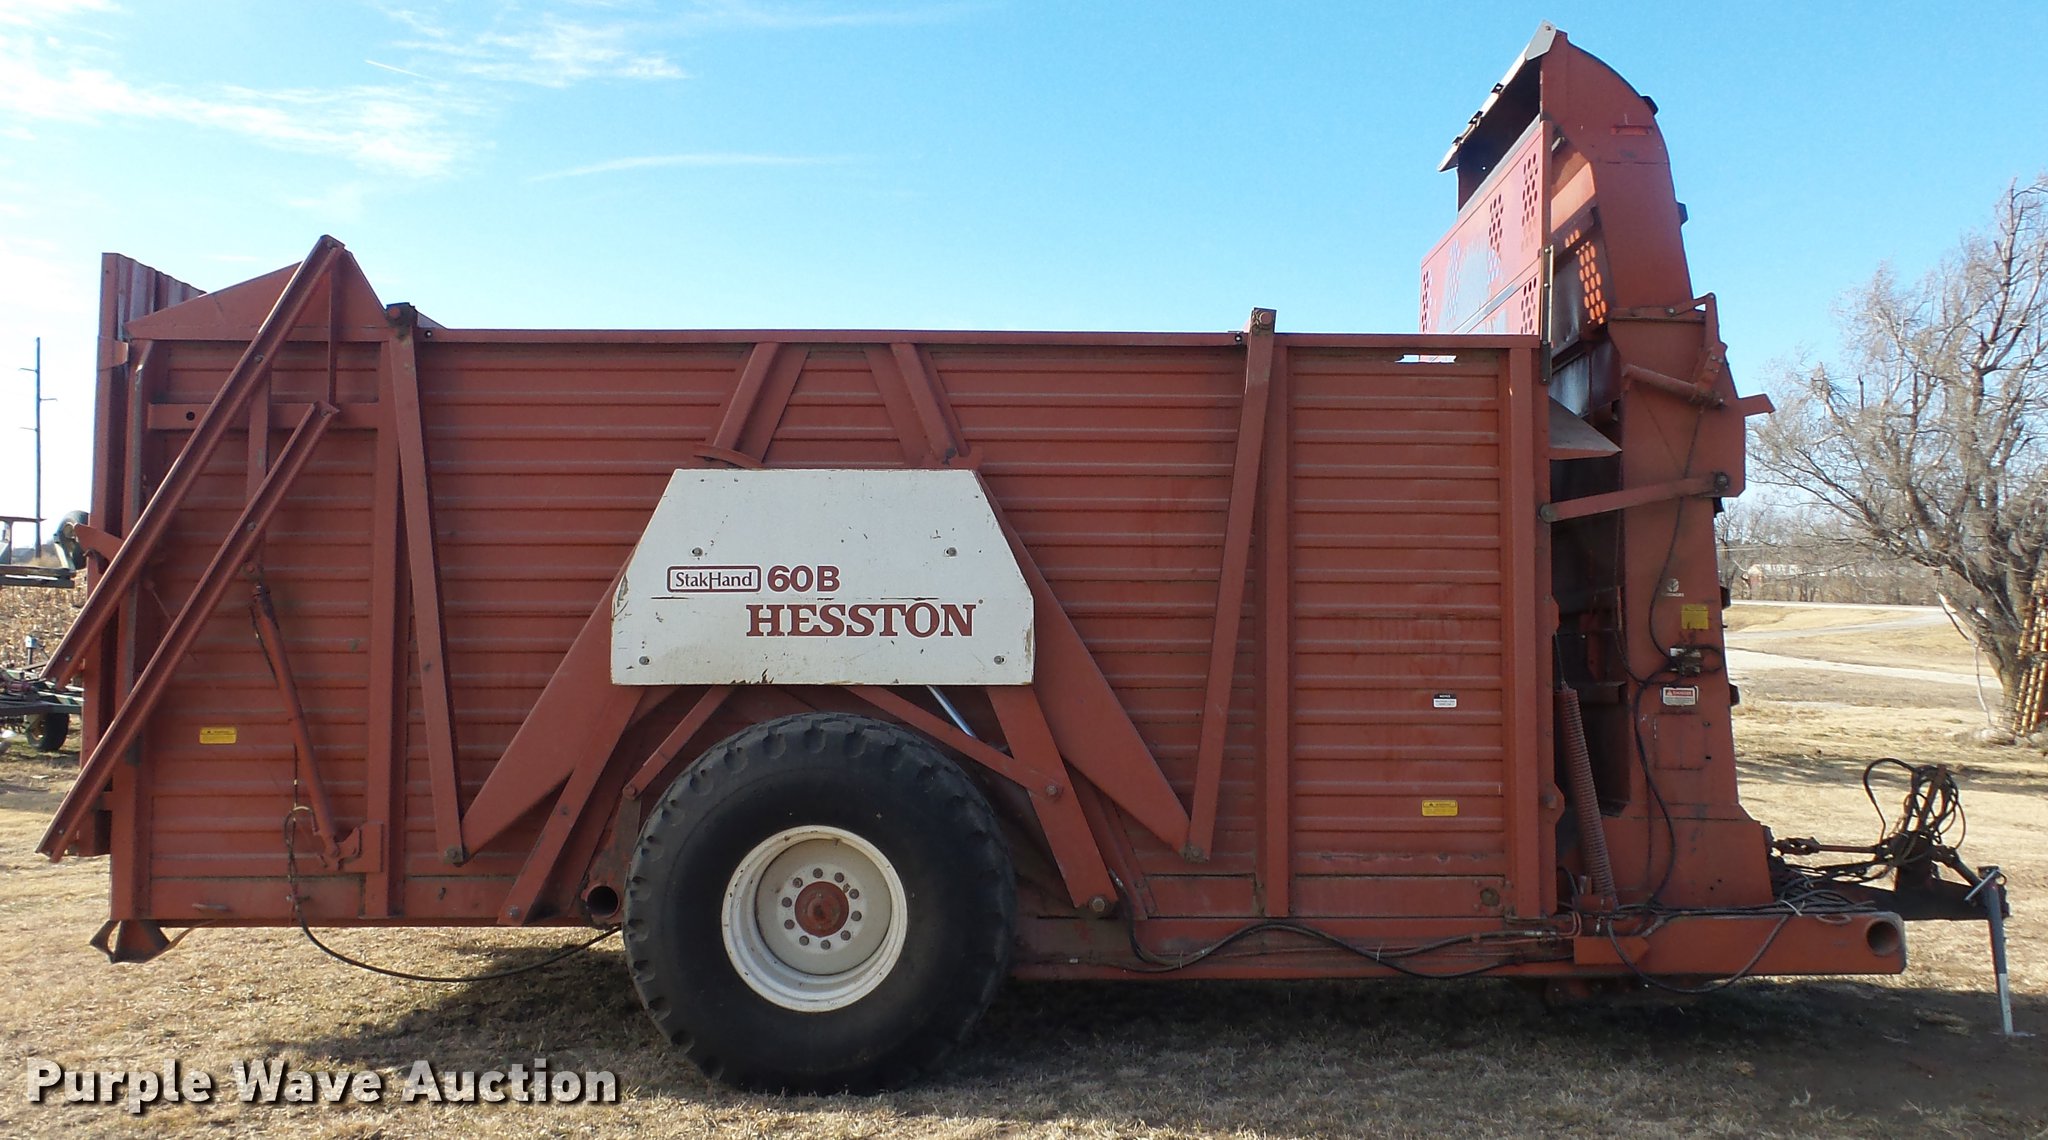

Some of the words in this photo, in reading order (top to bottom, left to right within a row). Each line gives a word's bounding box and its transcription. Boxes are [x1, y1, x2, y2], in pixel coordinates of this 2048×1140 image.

[675, 571, 753, 590] StakHand
[767, 565, 840, 593] 60B
[746, 603, 977, 638] HESSTON
